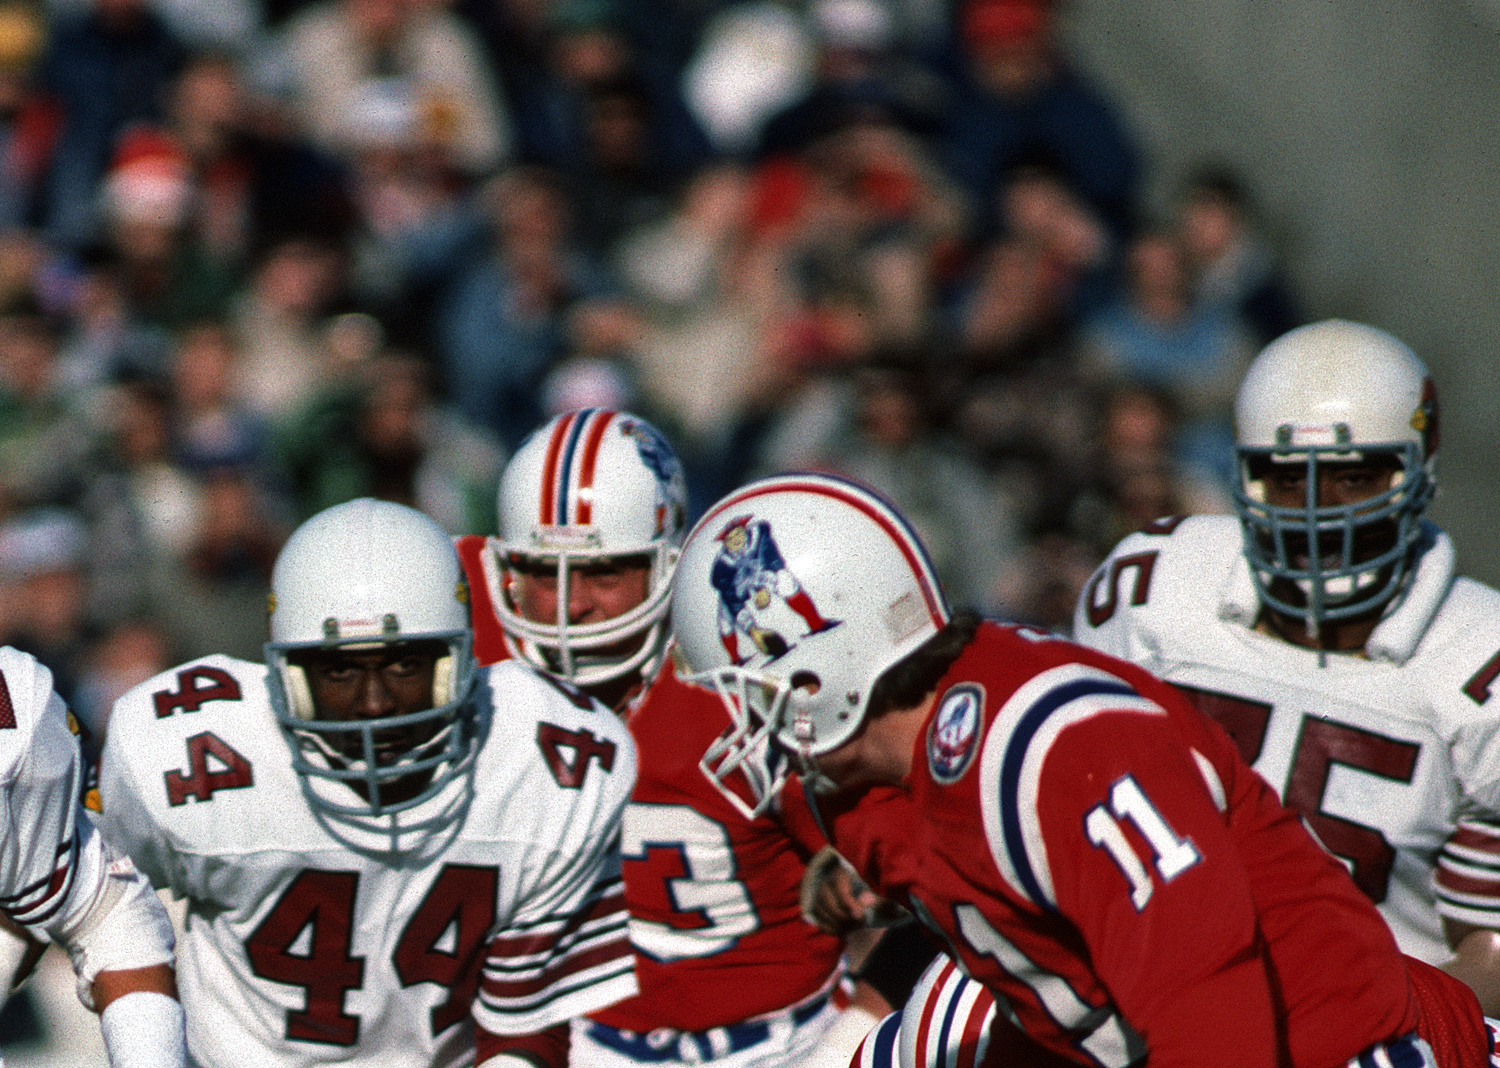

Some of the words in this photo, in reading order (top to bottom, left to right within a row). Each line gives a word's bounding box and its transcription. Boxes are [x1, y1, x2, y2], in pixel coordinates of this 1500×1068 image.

[153, 665, 255, 807] 44
[1083, 773, 1203, 913] 11
[244, 863, 500, 1046] 44
